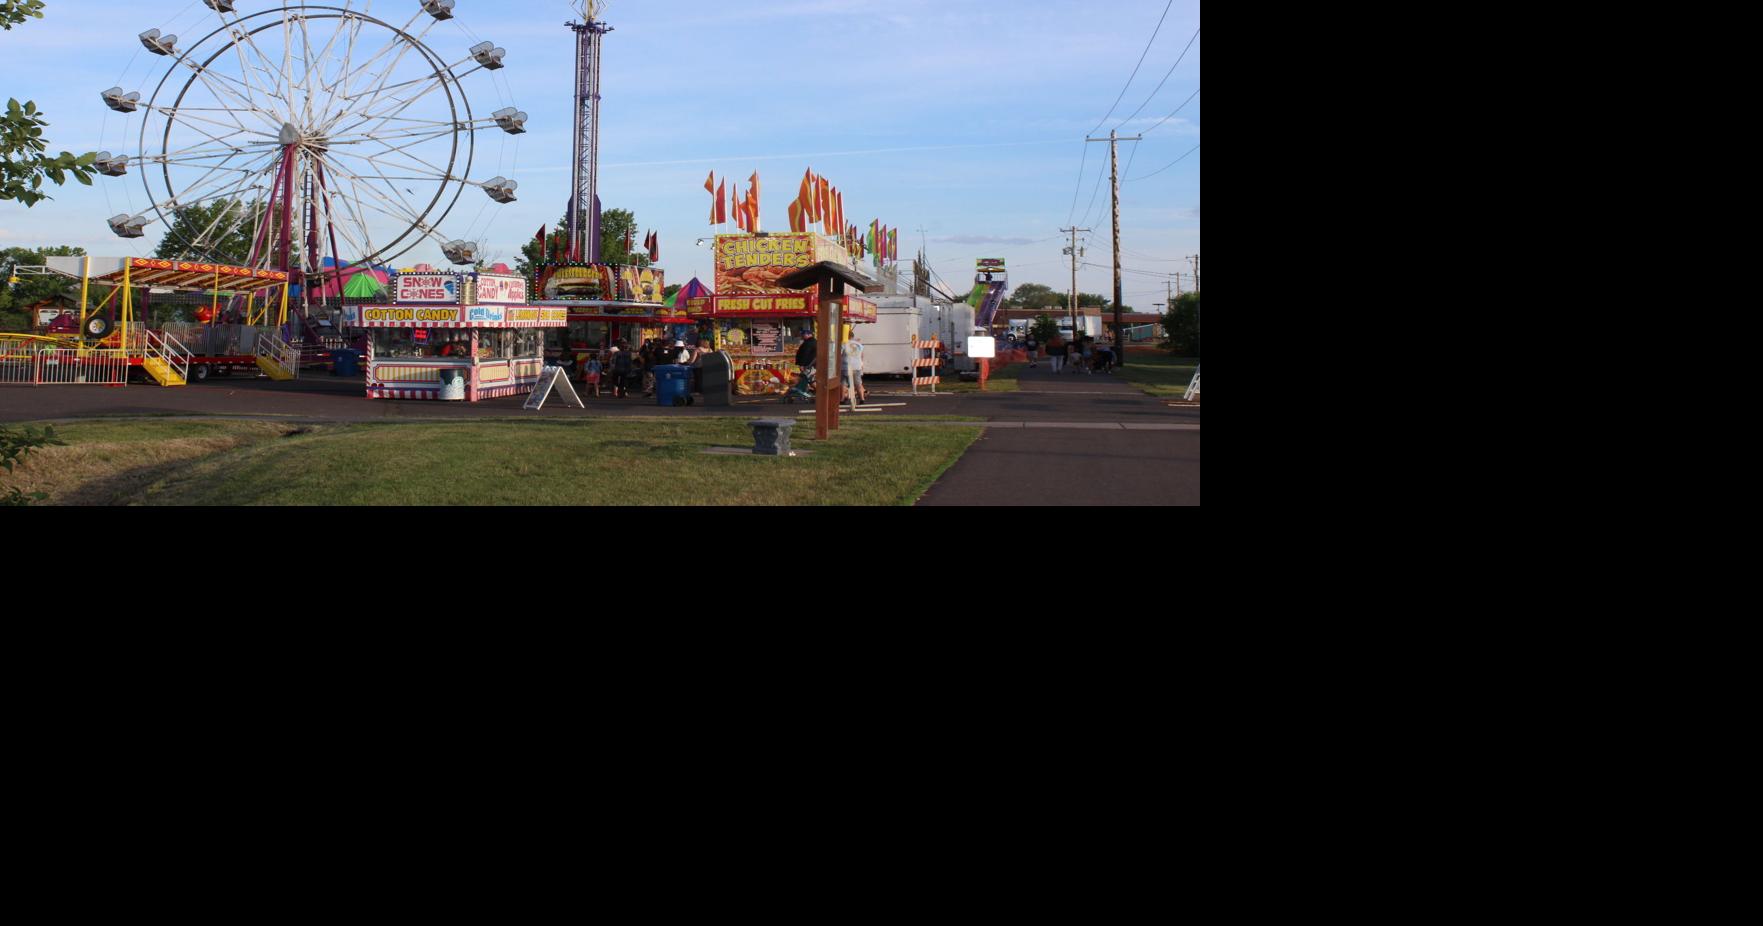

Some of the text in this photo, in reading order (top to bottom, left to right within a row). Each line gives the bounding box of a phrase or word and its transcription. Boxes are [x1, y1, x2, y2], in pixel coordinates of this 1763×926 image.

[722, 238, 808, 254] CHICKEN
[722, 252, 809, 269] TENDERS
[402, 277, 443, 288] SNOW
[400, 288, 445, 299] CONES
[478, 284, 498, 300] CANDY
[717, 297, 750, 310] FRESH
[752, 297, 774, 310] CUT
[775, 297, 805, 310] FRIES
[364, 308, 414, 321] COTTON
[416, 308, 459, 321] CANDY
